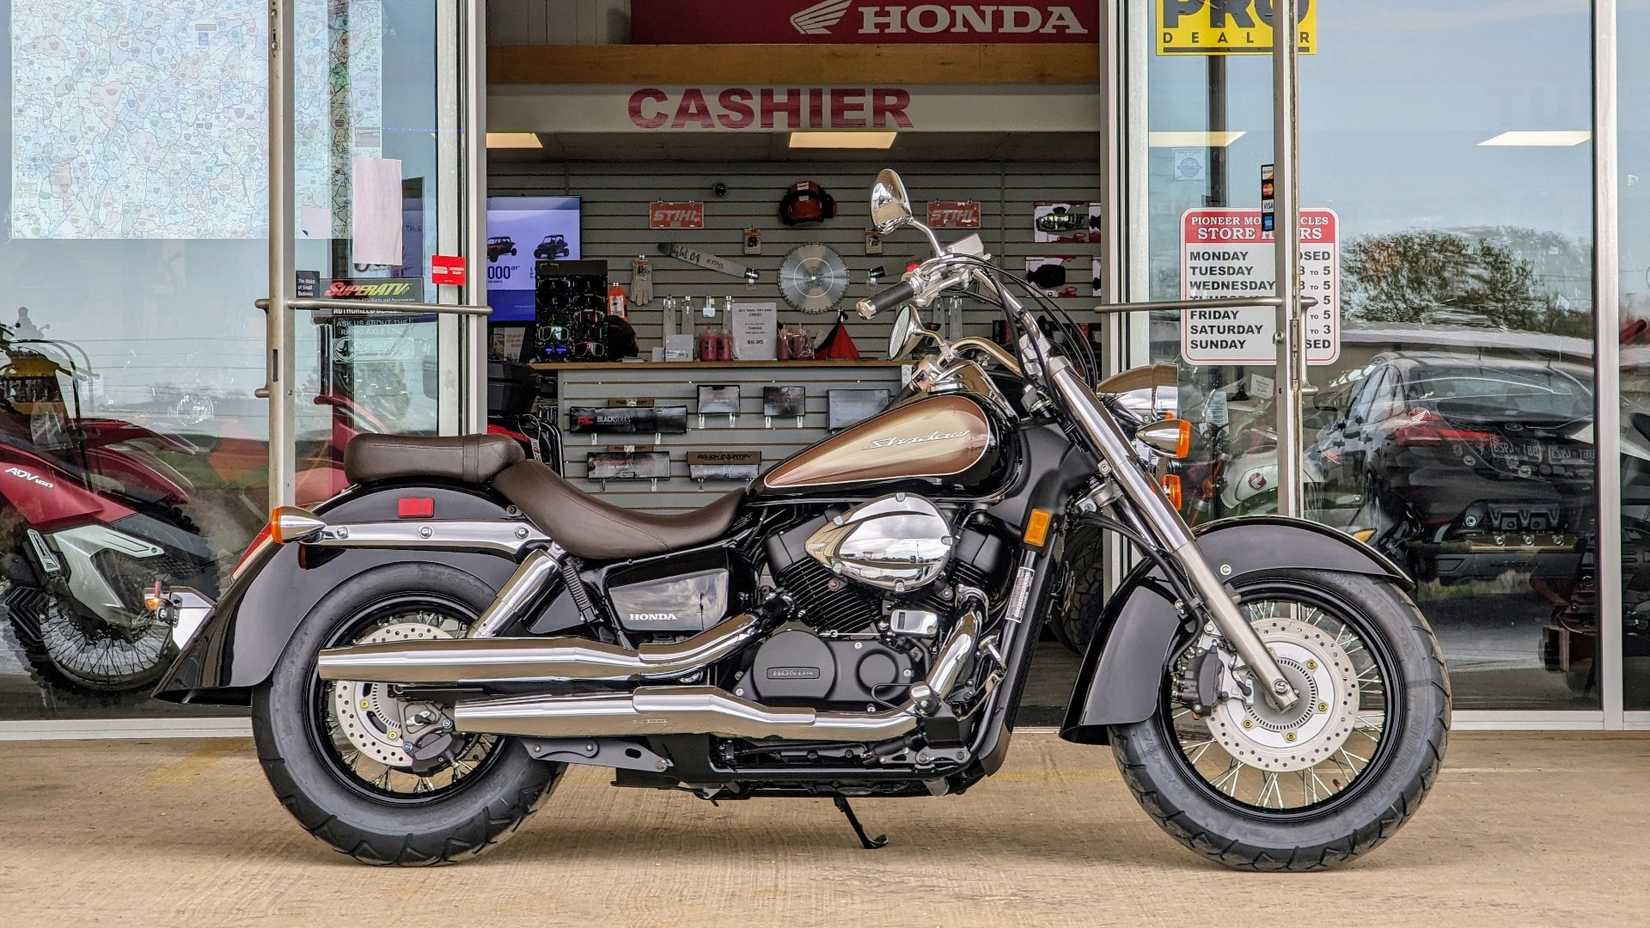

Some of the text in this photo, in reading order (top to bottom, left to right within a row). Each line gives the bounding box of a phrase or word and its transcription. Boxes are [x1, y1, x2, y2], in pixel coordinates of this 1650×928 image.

[858, 5, 1088, 34] HONDA
[1163, 32, 1309, 43] DEALR
[627, 87, 913, 129] CASHIER
[655, 209, 697, 221] STIHL
[931, 209, 974, 221] STIHL
[1191, 216, 1328, 225] PIONEER MOCLES
[1198, 228, 1322, 240] STORE HRS
[1190, 251, 1249, 261] MONDAY
[1190, 266, 1253, 276] TUESDAY
[1323, 266, 1331, 276] 5
[1190, 281, 1275, 290] WEDNESDAY
[1323, 281, 1331, 290] 5
[1323, 295, 1331, 305] 5
[1190, 310, 1239, 319] FRIDAY
[1323, 310, 1331, 319] 5
[1190, 325, 1263, 335] SATURDAY
[1323, 325, 1331, 334] 3
[1190, 339, 1246, 349] SUNDAY
[5, 467, 40, 481] ADV
[629, 613, 677, 621] HONDA
